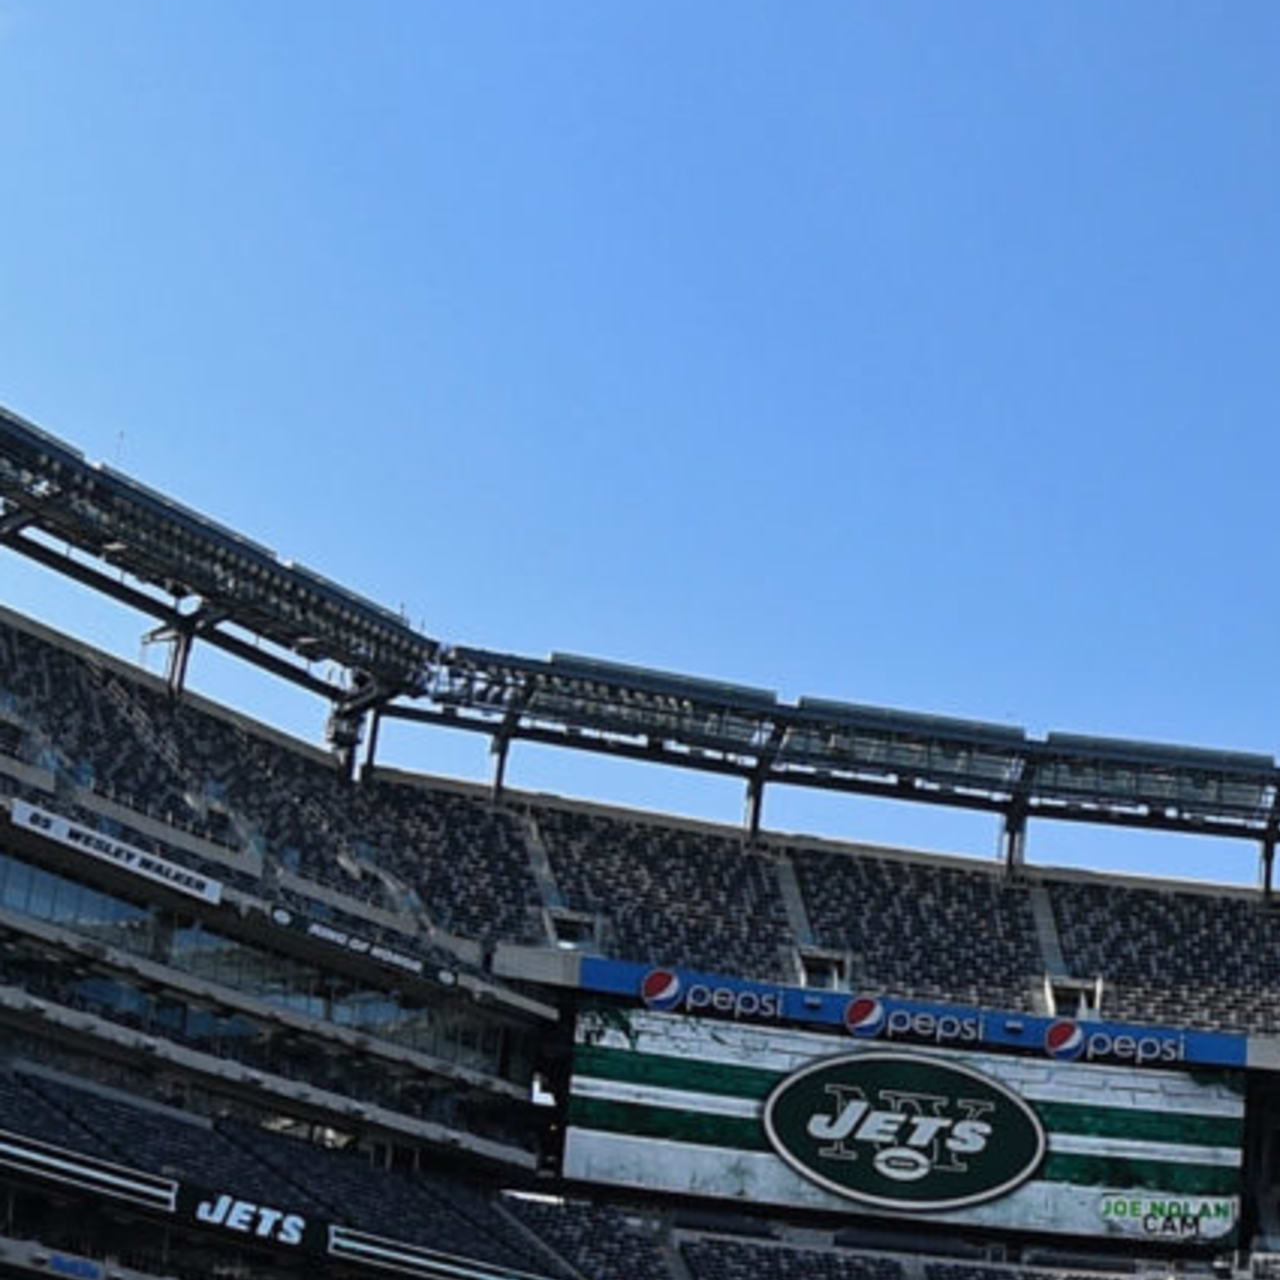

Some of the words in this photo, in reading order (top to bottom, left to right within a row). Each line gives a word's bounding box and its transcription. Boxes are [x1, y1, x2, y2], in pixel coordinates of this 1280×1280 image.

[68, 827, 139, 864] WESLEY
[138, 857, 207, 894] WALKER
[686, 984, 784, 1019] pepsi
[887, 1010, 984, 1044] pepsi
[1087, 1032, 1186, 1064] pepsi
[807, 1099, 993, 1153] JETS
[196, 1194, 305, 1245] JETS
[1102, 1199, 1142, 1217] JOE
[1150, 1200, 1230, 1219] NOLAN
[1143, 1213, 1200, 1235] CAM
